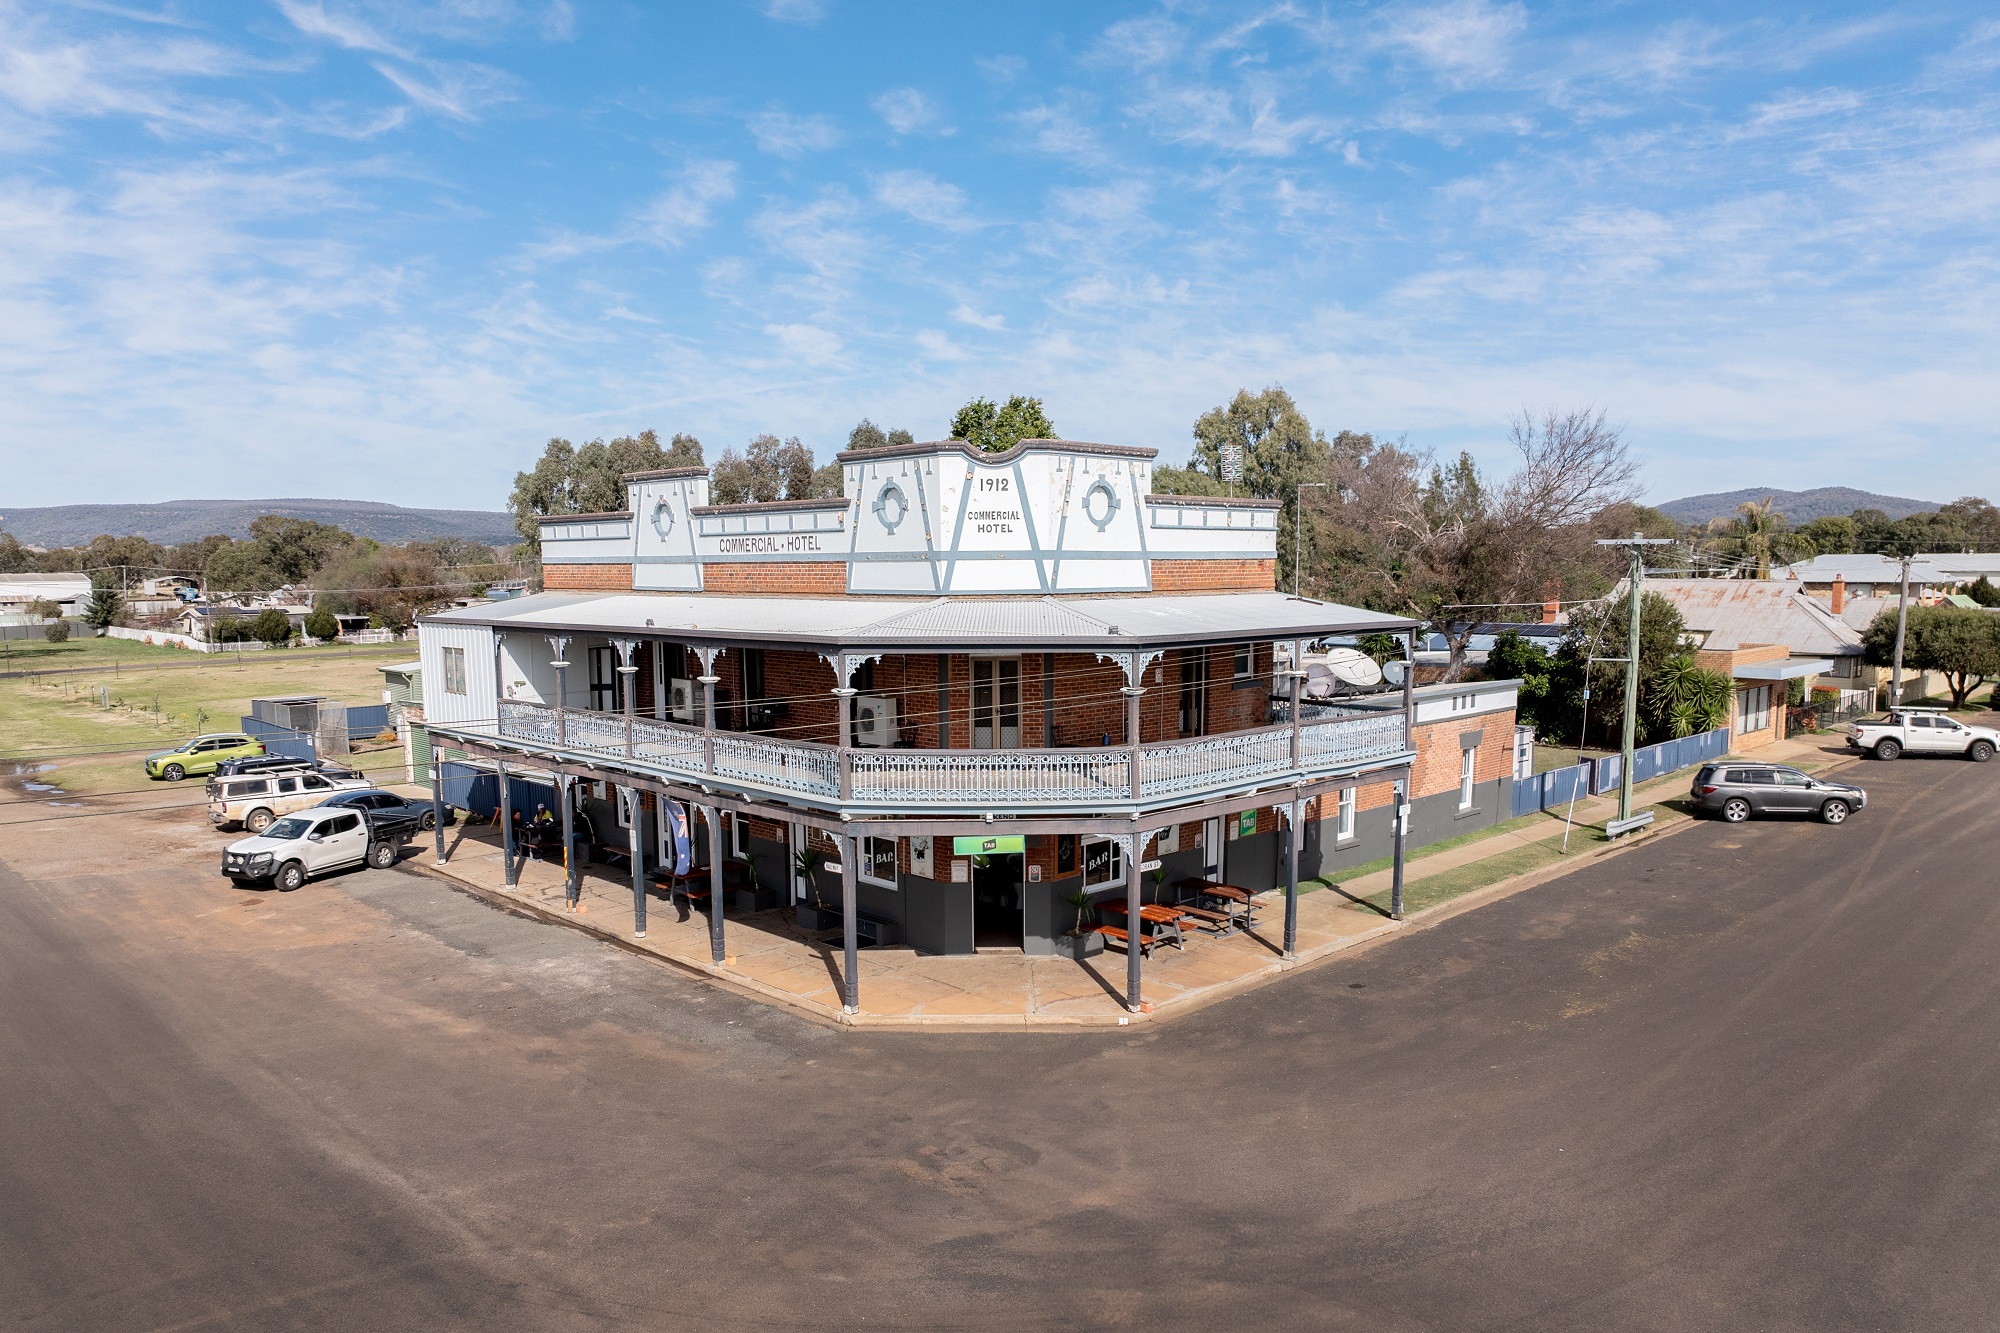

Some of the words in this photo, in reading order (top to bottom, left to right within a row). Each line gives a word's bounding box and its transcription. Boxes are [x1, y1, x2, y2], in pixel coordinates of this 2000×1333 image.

[980, 478, 1009, 491] 1912
[967, 511, 1020, 520] COMMERCIAL
[977, 524, 1013, 533] HOTEL
[719, 537, 779, 553] COMMERCIAL
[787, 536, 821, 552] HOTEL
[1242, 818, 1255, 828] TAB
[875, 852, 894, 864] BAR
[1088, 851, 1108, 871] BAR
